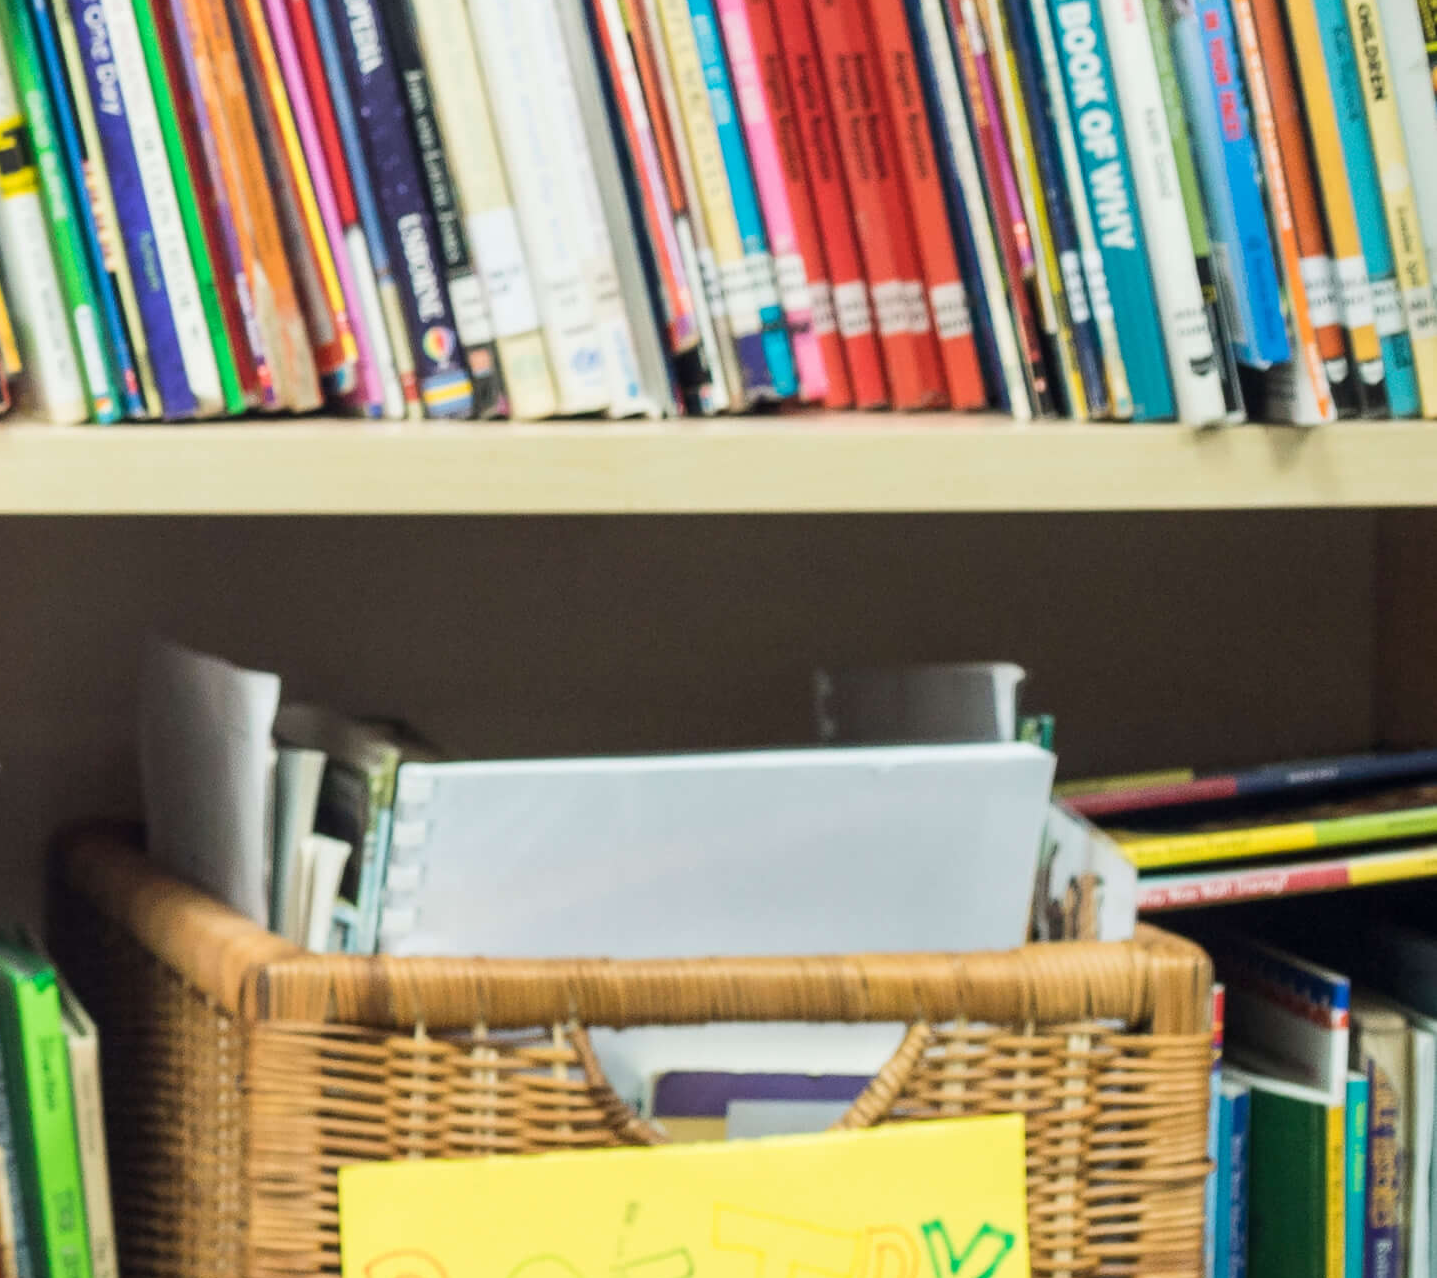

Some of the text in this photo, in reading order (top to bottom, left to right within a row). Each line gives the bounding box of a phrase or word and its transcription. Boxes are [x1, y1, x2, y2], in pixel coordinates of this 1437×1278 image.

[78, 1, 114, 64] One
[1352, 1, 1392, 103] CHILDREN
[89, 61, 127, 119] Day
[1076, 105, 1118, 164] OF
[1085, 159, 1136, 255] WHY
